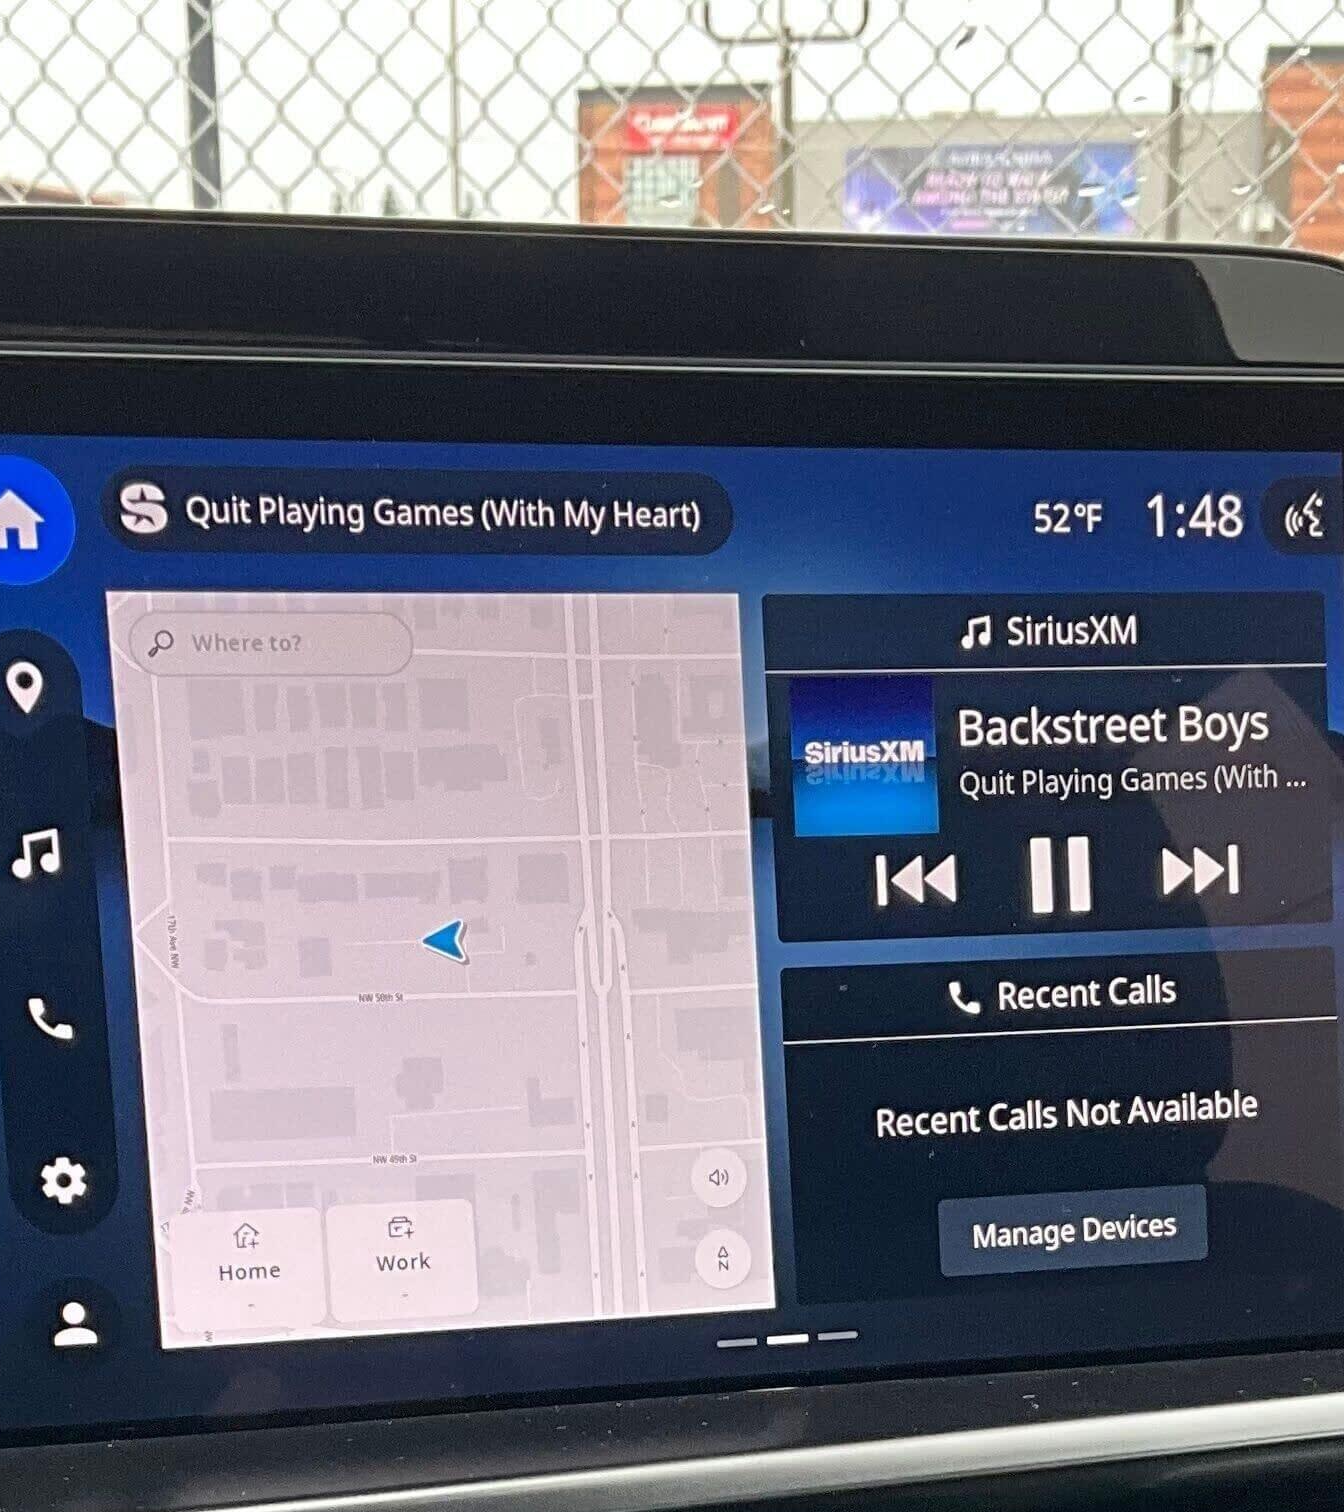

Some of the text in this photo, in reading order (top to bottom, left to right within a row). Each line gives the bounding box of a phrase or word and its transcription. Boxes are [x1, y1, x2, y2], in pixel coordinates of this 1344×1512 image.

[186, 496, 250, 529] Quit
[259, 496, 365, 533] Playing
[373, 498, 473, 528] Games
[481, 497, 555, 532] (With
[564, 500, 605, 534] My
[612, 499, 700, 532] Heart)
[1034, 493, 1245, 539] 52°F 1:48
[191, 633, 302, 653] Where to?
[1006, 614, 1139, 647] SiriusXM
[958, 706, 1270, 752] Backstreet Boys
[804, 740, 924, 764] SiriusXM
[959, 768, 1015, 799] Quit
[1022, 767, 1113, 801] Playing
[1121, 765, 1208, 793] Games
[1213, 763, 1279, 796] (With
[997, 974, 1177, 1012] Recent Calls
[876, 1089, 1258, 1138] Recent Calls Not Available
[972, 1213, 1177, 1253] Manage Devices
[218, 1261, 282, 1283] Home
[376, 1250, 431, 1273] Work
